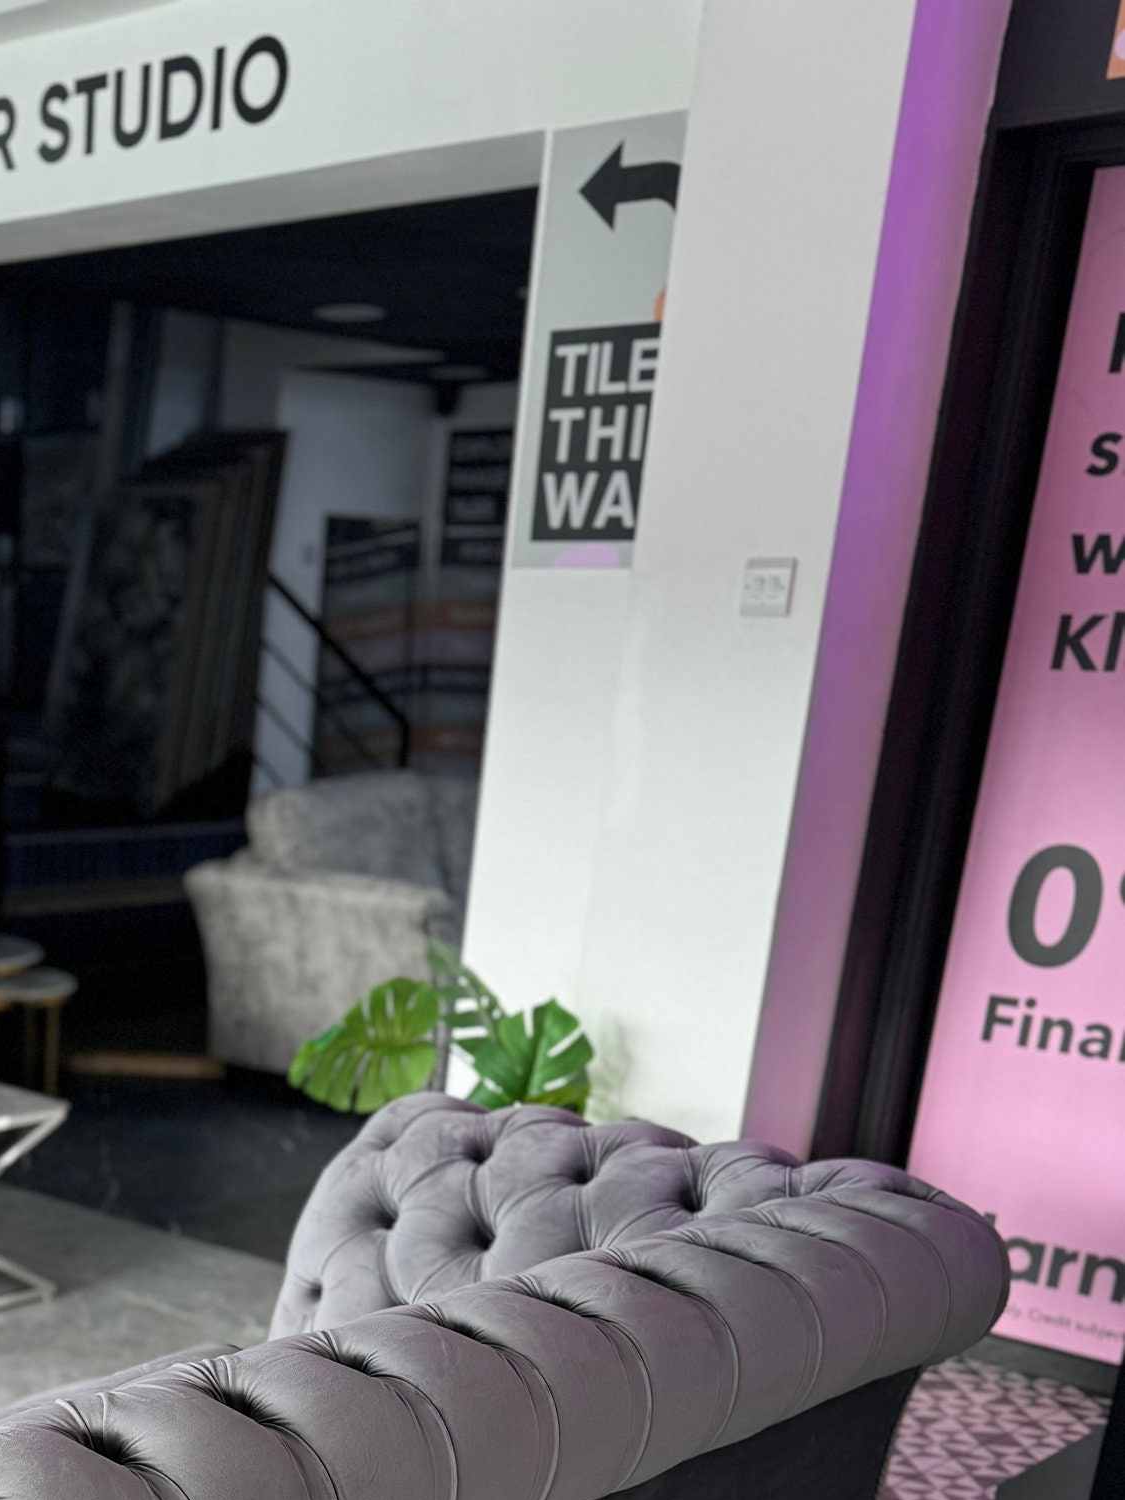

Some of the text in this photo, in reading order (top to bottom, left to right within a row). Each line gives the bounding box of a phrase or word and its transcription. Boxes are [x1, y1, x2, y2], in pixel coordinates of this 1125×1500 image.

[38, 35, 289, 164] STUDIO
[554, 337, 661, 397] TILE
[548, 403, 648, 464] THI
[542, 469, 635, 530] WA
[1006, 842, 1125, 969] 0
[983, 1211, 1125, 1304] arn
